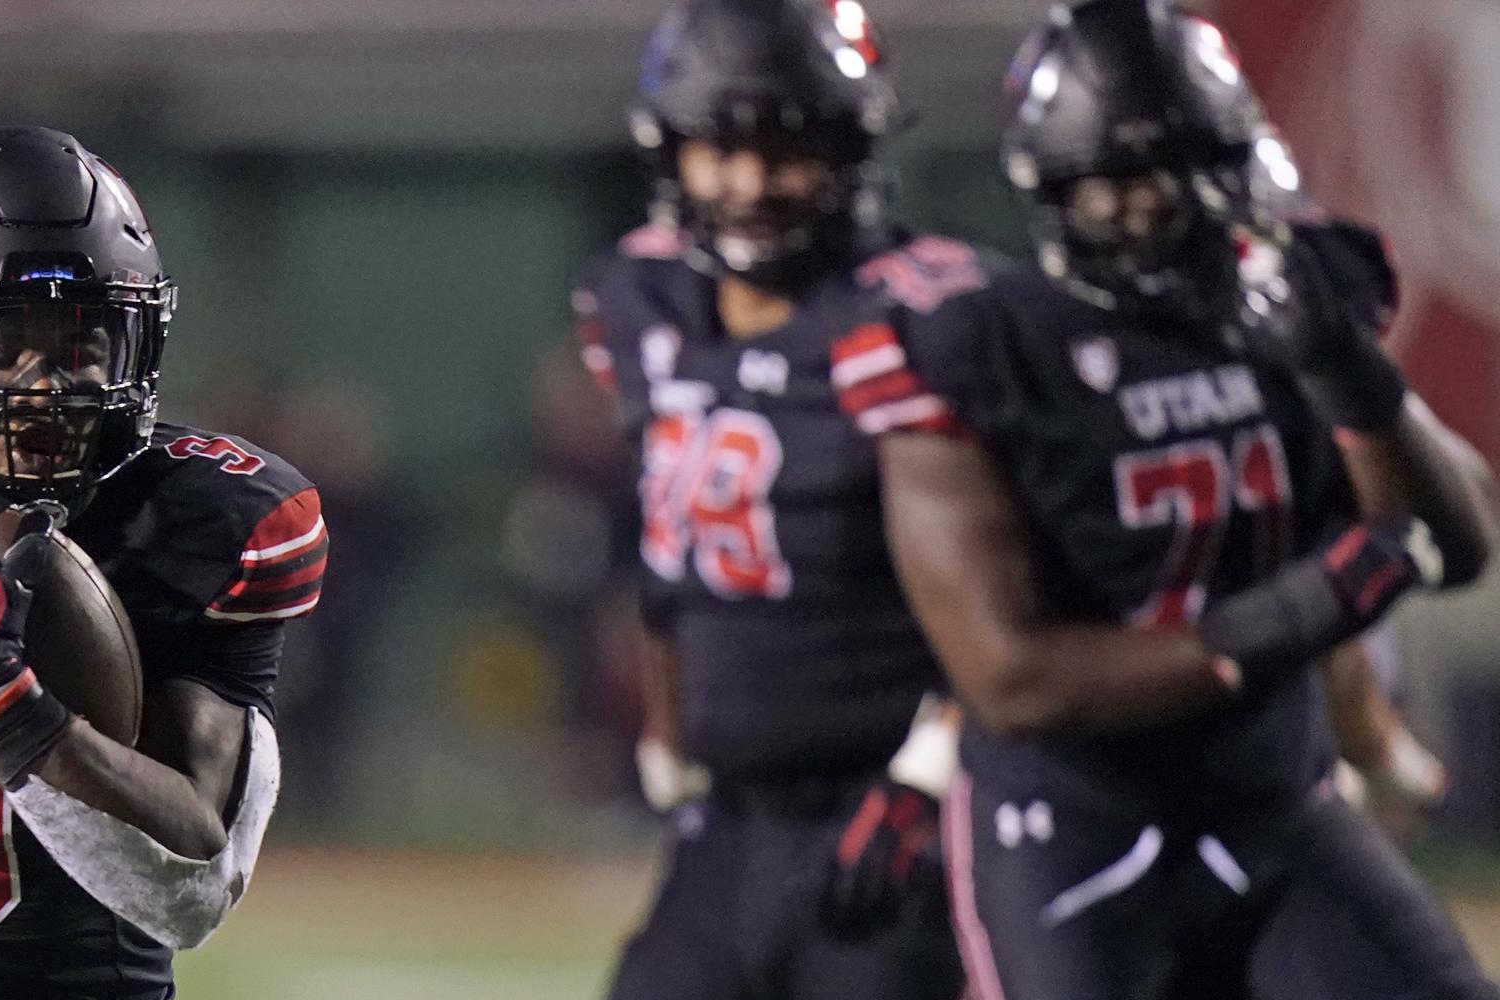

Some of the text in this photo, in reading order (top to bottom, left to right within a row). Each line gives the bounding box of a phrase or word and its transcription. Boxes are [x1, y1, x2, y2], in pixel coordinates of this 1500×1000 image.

[1117, 363, 1267, 441] UTAH
[164, 435, 266, 475] 9
[1113, 422, 1297, 628] 71
